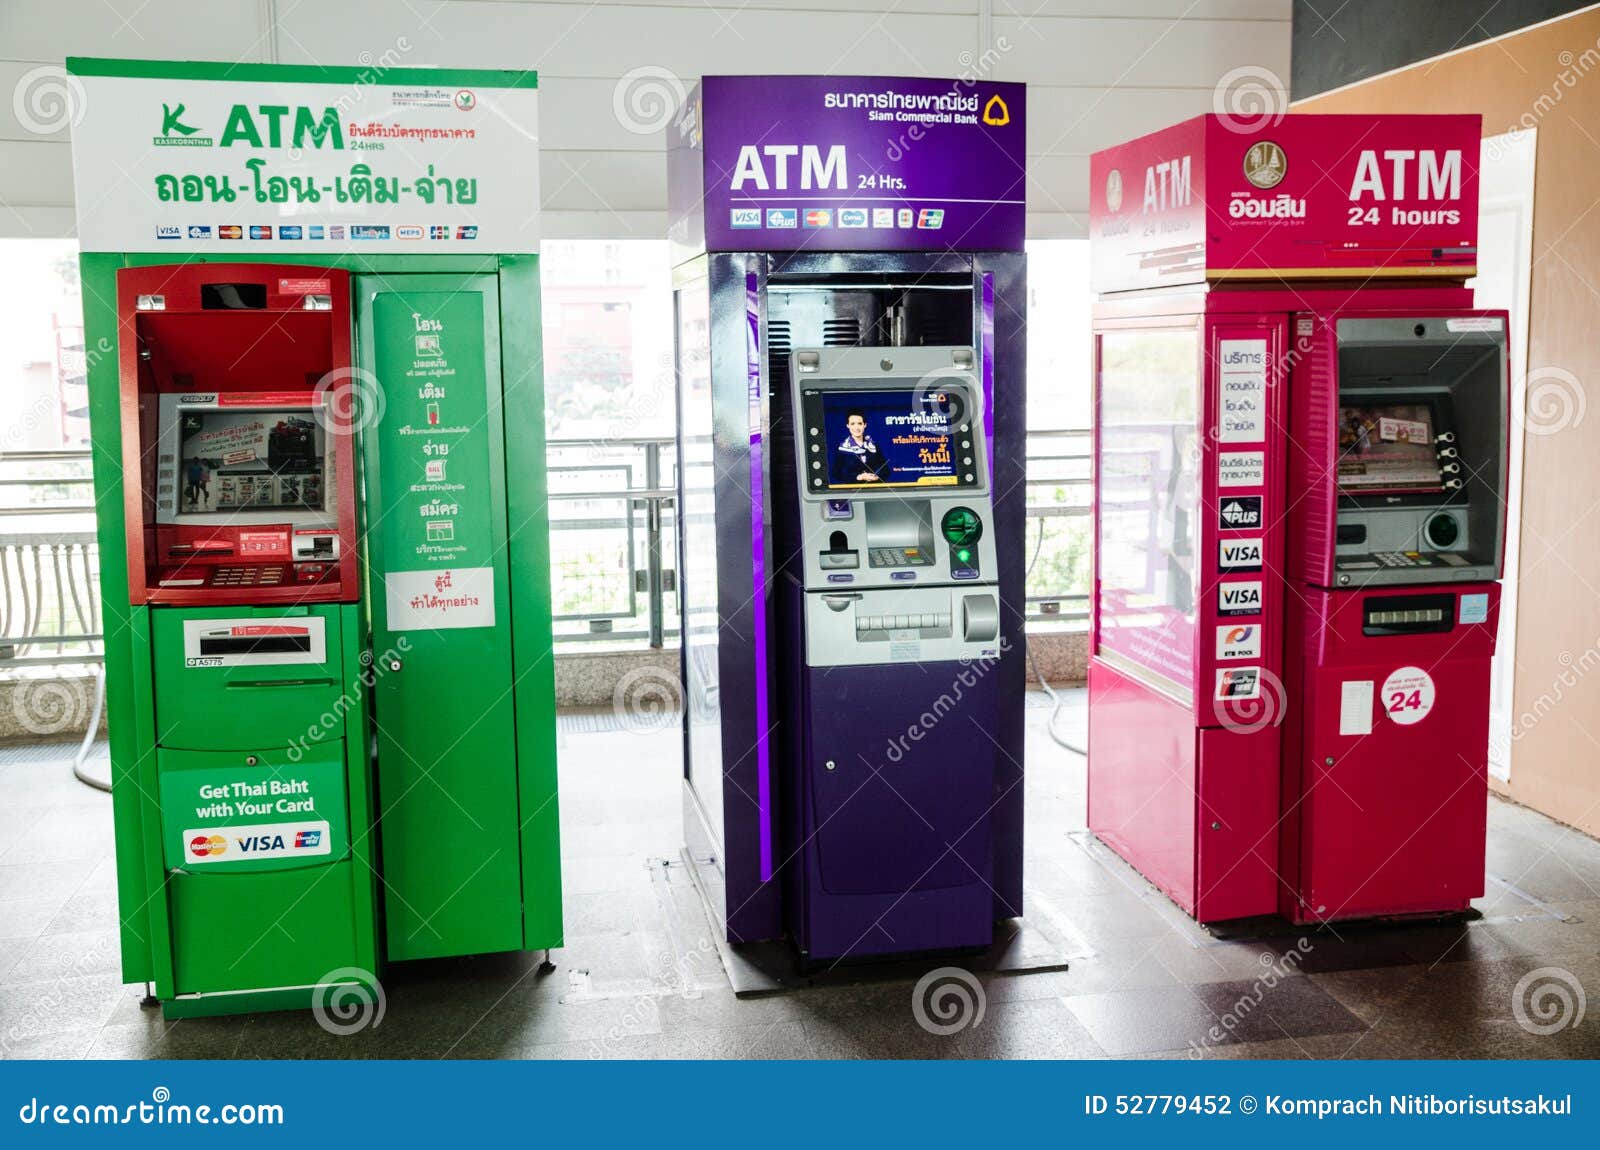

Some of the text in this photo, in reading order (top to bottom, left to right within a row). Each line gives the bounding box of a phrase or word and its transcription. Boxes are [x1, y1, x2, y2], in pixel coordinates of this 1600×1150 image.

[824, 91, 979, 112] ธนาคารไทยพาณิชย์
[869, 111, 978, 124] Siam Commercial Bank
[219, 104, 345, 150] ATM
[730, 145, 849, 190] ATM
[1348, 149, 1462, 201] ATM
[858, 175, 907, 190] 24 Hrs.
[1142, 155, 1192, 216] ATM
[1229, 194, 1306, 218] ออมสิน
[734, 211, 759, 223] VISA
[1347, 207, 1461, 226] 24 hours
[160, 226, 180, 234] VISA
[411, 313, 443, 331] โอน
[418, 382, 446, 399] เติม
[422, 439, 449, 456] จ่าย
[918, 443, 951, 464] วันนี้!
[420, 499, 458, 516] สมัคร
[1231, 511, 1259, 524] PLUS
[1224, 546, 1260, 561] VISA
[410, 594, 479, 612] ทำได้ทุกอย่าง
[1223, 589, 1260, 604] VISA
[1389, 690, 1422, 712] 24
[200, 779, 309, 800] Get Thai Baht
[196, 797, 315, 819] with Your Card
[236, 835, 286, 852] VISA
